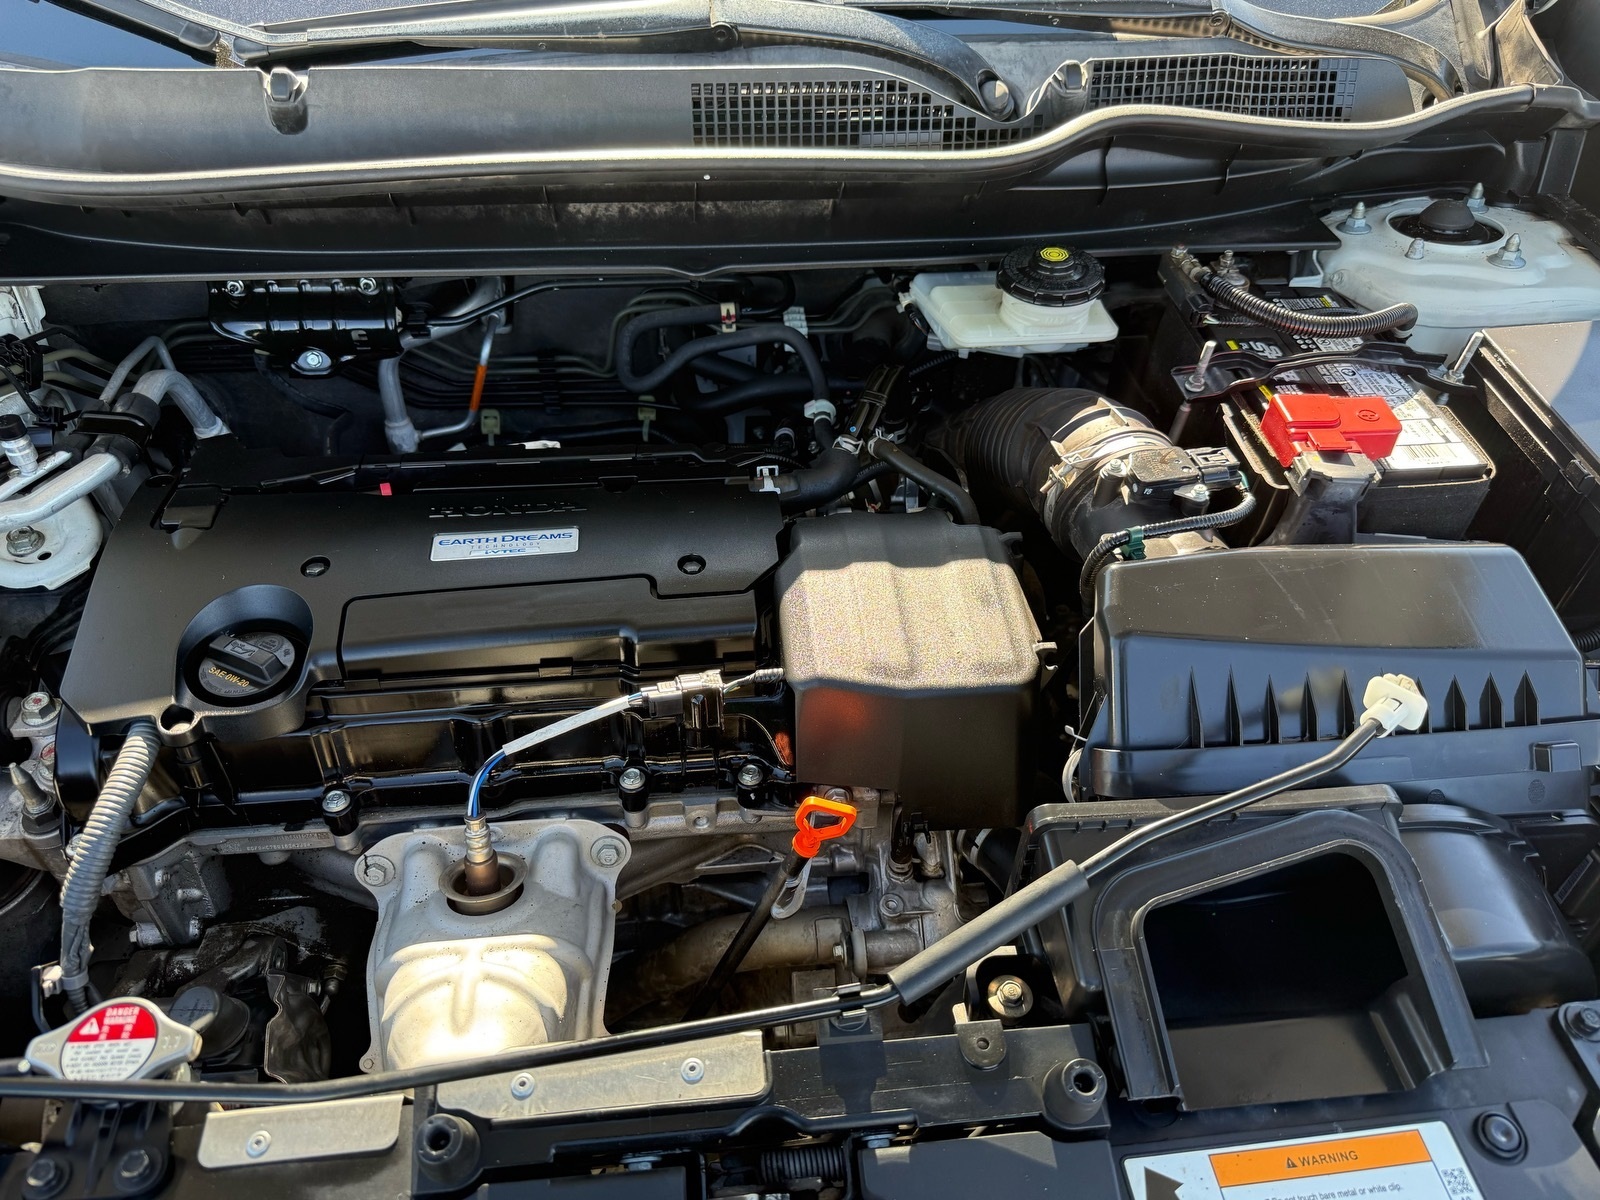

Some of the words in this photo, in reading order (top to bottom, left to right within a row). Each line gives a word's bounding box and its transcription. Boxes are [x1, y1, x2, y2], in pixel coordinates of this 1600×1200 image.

[438, 537, 497, 546] EARTH
[501, 532, 573, 543] DREAMS
[208, 666, 228, 679] SAE
[224, 673, 250, 688] 0W-20
[104, 1006, 140, 1017] DANGER
[1298, 1150, 1359, 1167] WARNING
[1318, 1191, 1336, 1200] bare
[1337, 1187, 1358, 1198] metal
[1367, 1184, 1387, 1194] white
